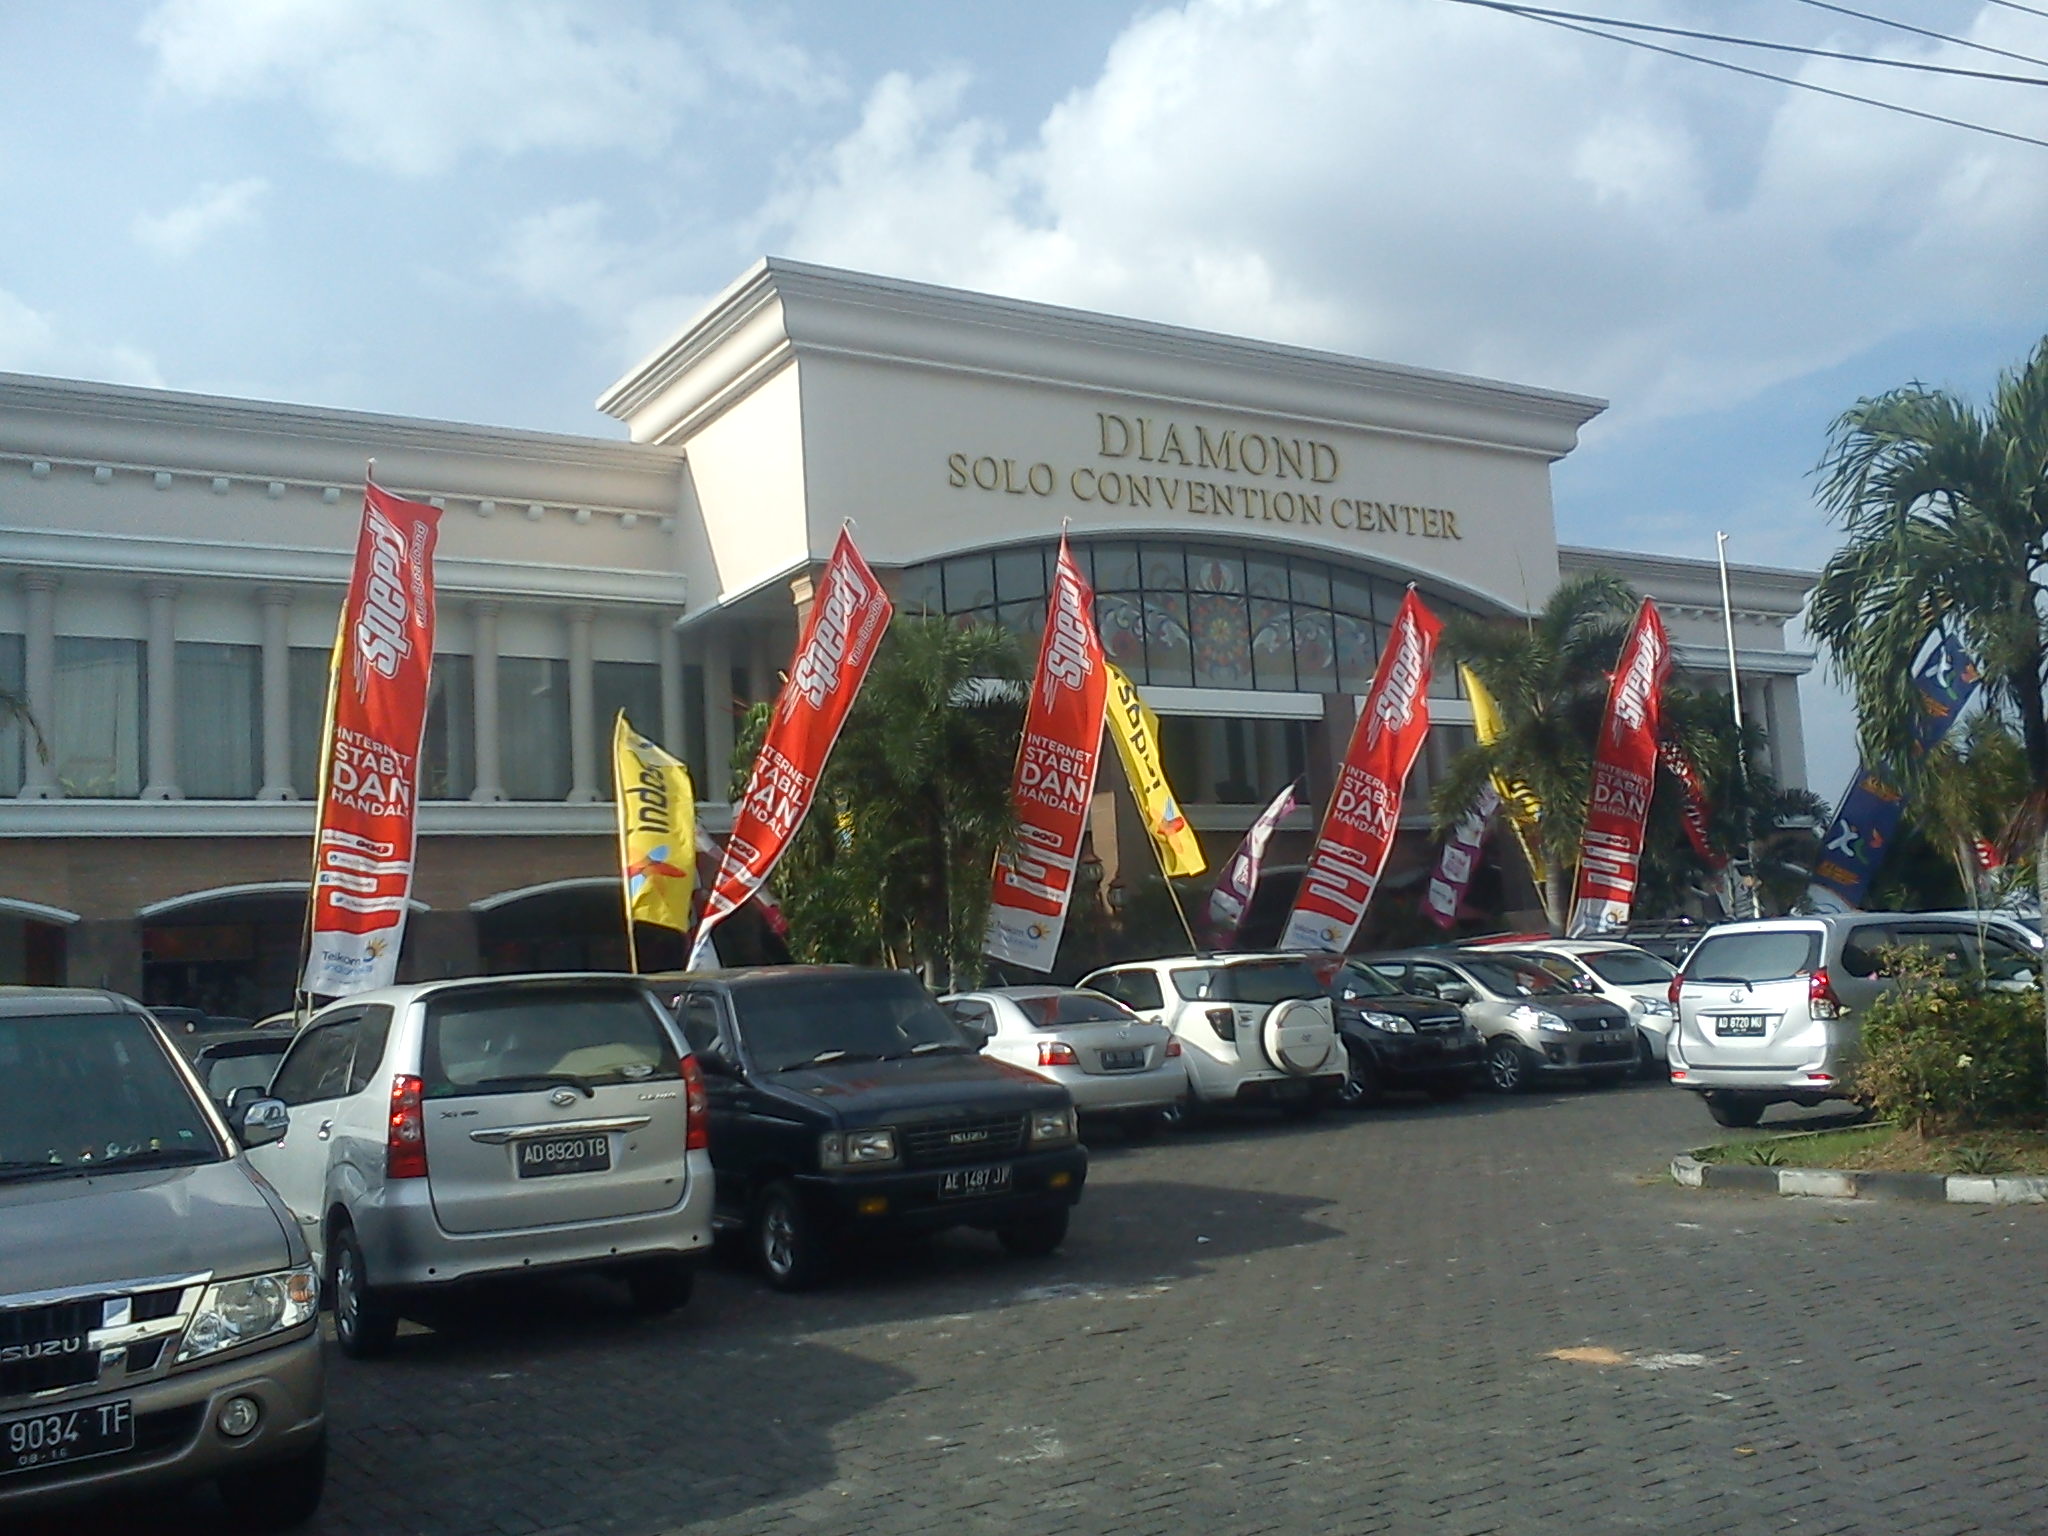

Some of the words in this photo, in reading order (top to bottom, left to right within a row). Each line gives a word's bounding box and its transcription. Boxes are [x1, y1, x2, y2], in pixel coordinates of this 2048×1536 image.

[1096, 411, 1341, 484] DIAMOND
[948, 451, 1055, 497] SOLO
[1070, 466, 1323, 526] CONVENTION
[1330, 496, 1463, 541] CENTER
[336, 725, 412, 767] INTERNT
[1025, 746, 1088, 780] STABIL
[1027, 732, 1092, 763] INTERNET
[333, 759, 410, 809] DAN
[757, 754, 804, 807] TABIL
[1020, 761, 1086, 803] DAN
[1343, 776, 1395, 815] STABIL
[1598, 771, 1646, 799] STABIL
[1336, 789, 1393, 832] DAN
[1595, 784, 1646, 816] DAN
[322, 950, 361, 965] Telkom
[524, 1144, 544, 1163] AD
[545, 1140, 585, 1161] 8920
[587, 1138, 606, 1157] TB
[950, 1130, 988, 1144] ISUZU
[964, 1168, 991, 1188] 1487
[0, 1337, 80, 1361] SUZU
[10, 1411, 80, 1453] 9034
[97, 1402, 130, 1436] TF
